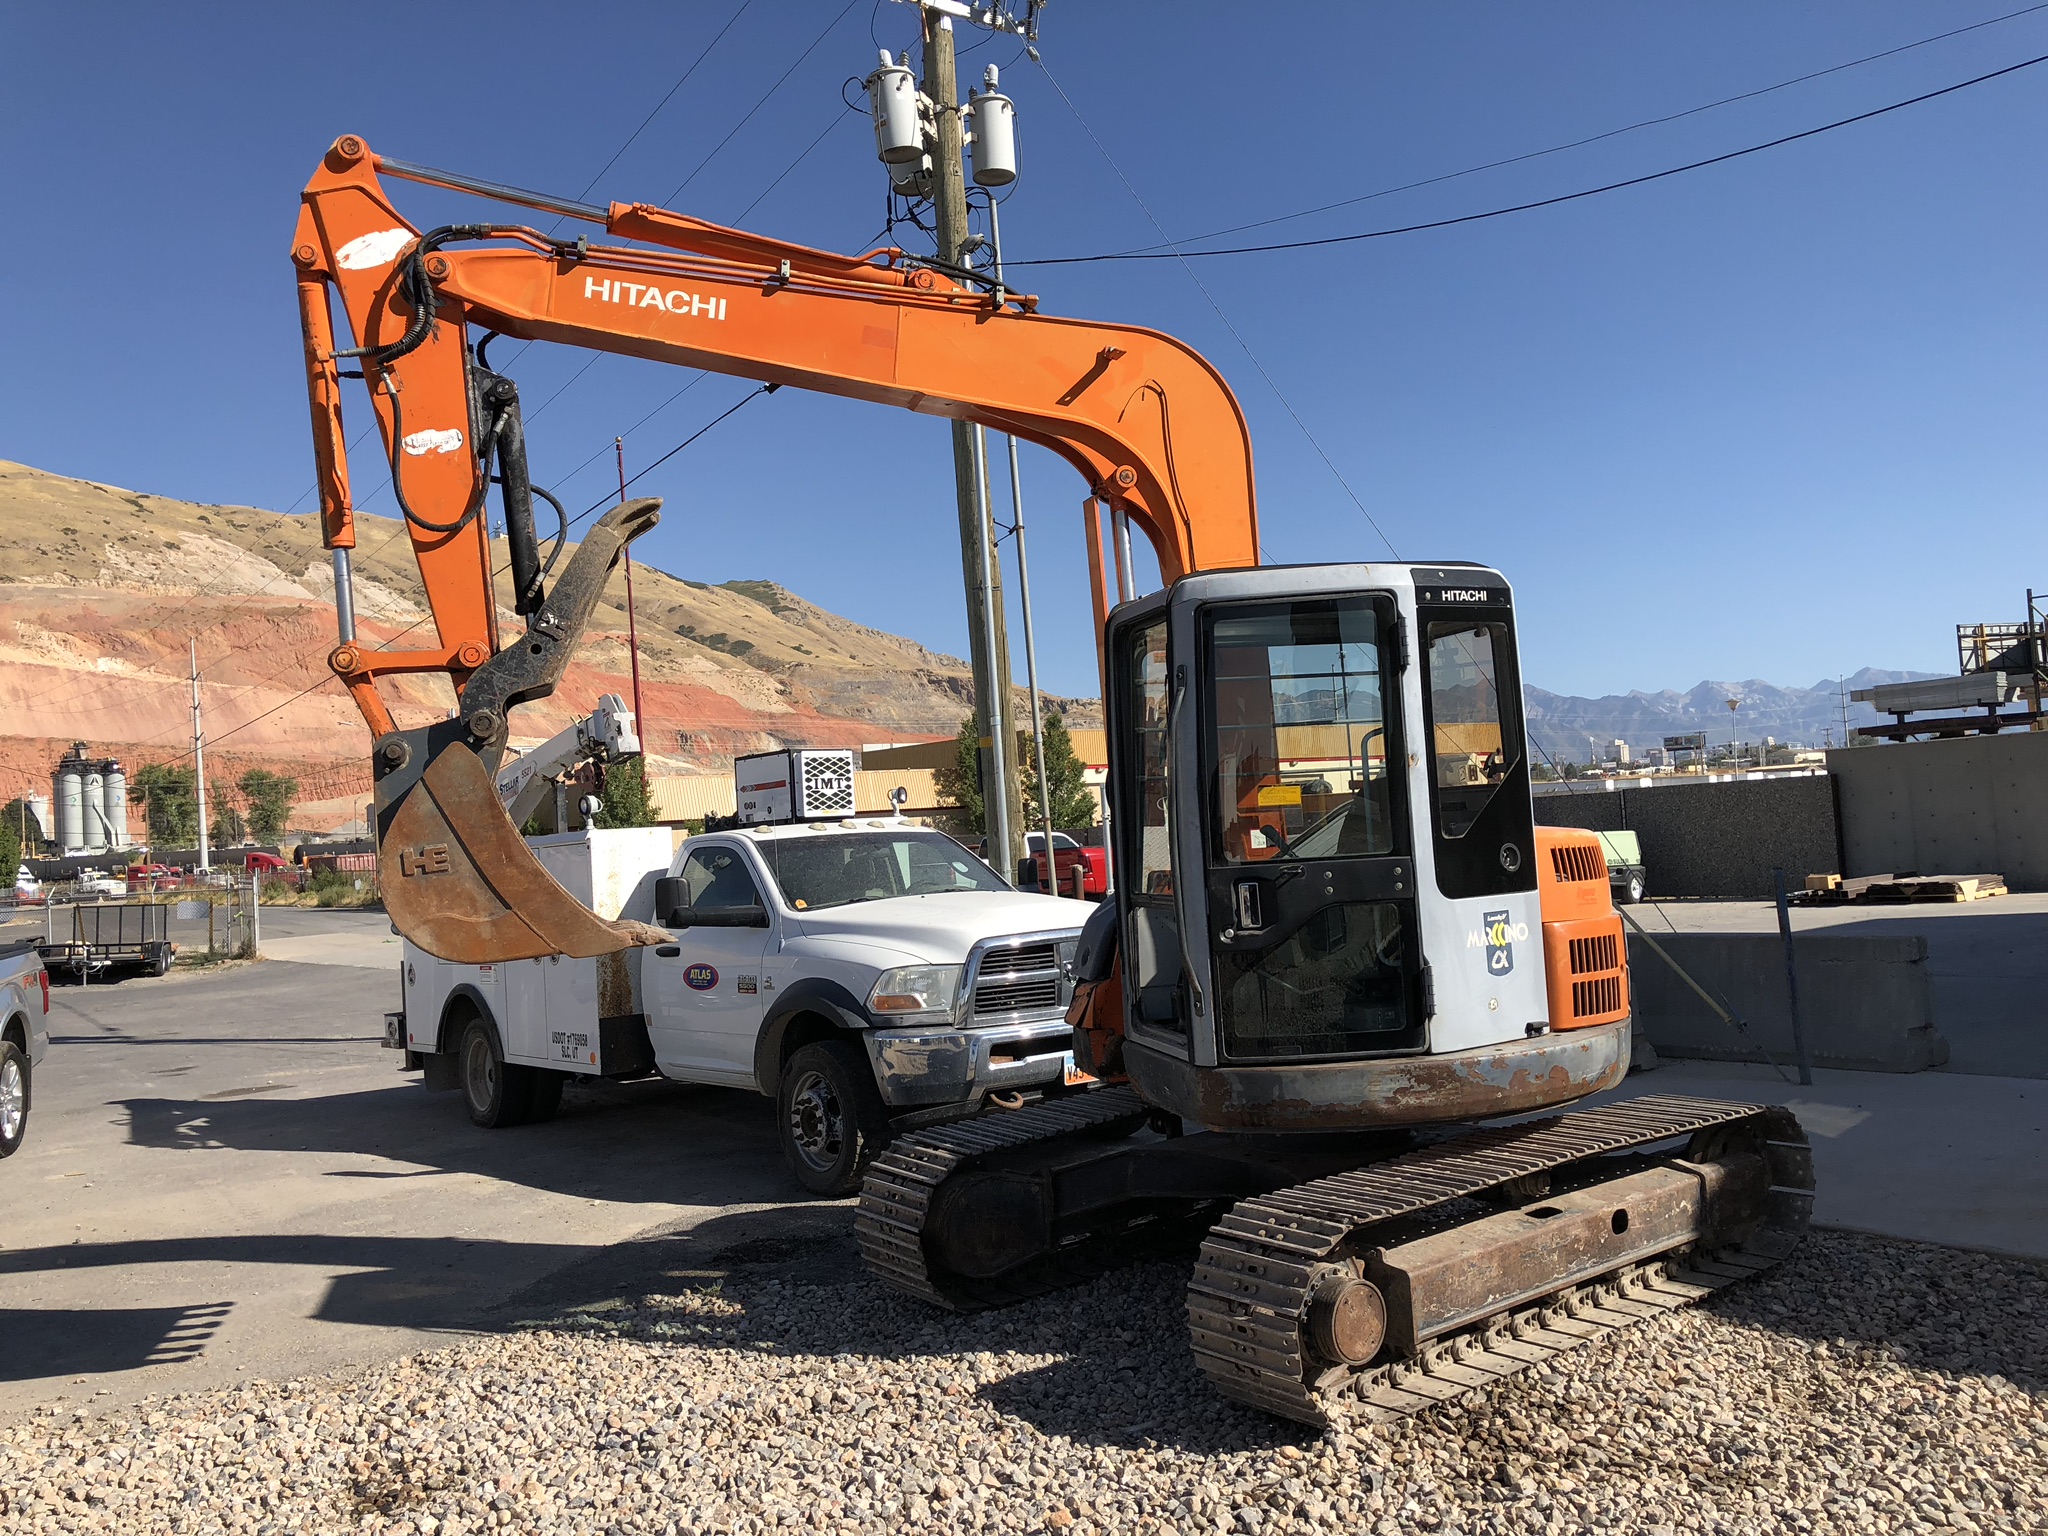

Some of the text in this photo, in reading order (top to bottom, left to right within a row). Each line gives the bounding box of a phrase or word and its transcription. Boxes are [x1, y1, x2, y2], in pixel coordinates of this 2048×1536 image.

[584, 276, 727, 321] HITACHI
[1441, 590, 1488, 601] HITACHI
[813, 778, 844, 790] IMT
[400, 843, 450, 877] HE
[690, 969, 711, 980] ATLAS
[551, 1031, 566, 1045] USDOT
[572, 1046, 579, 1059] UT
